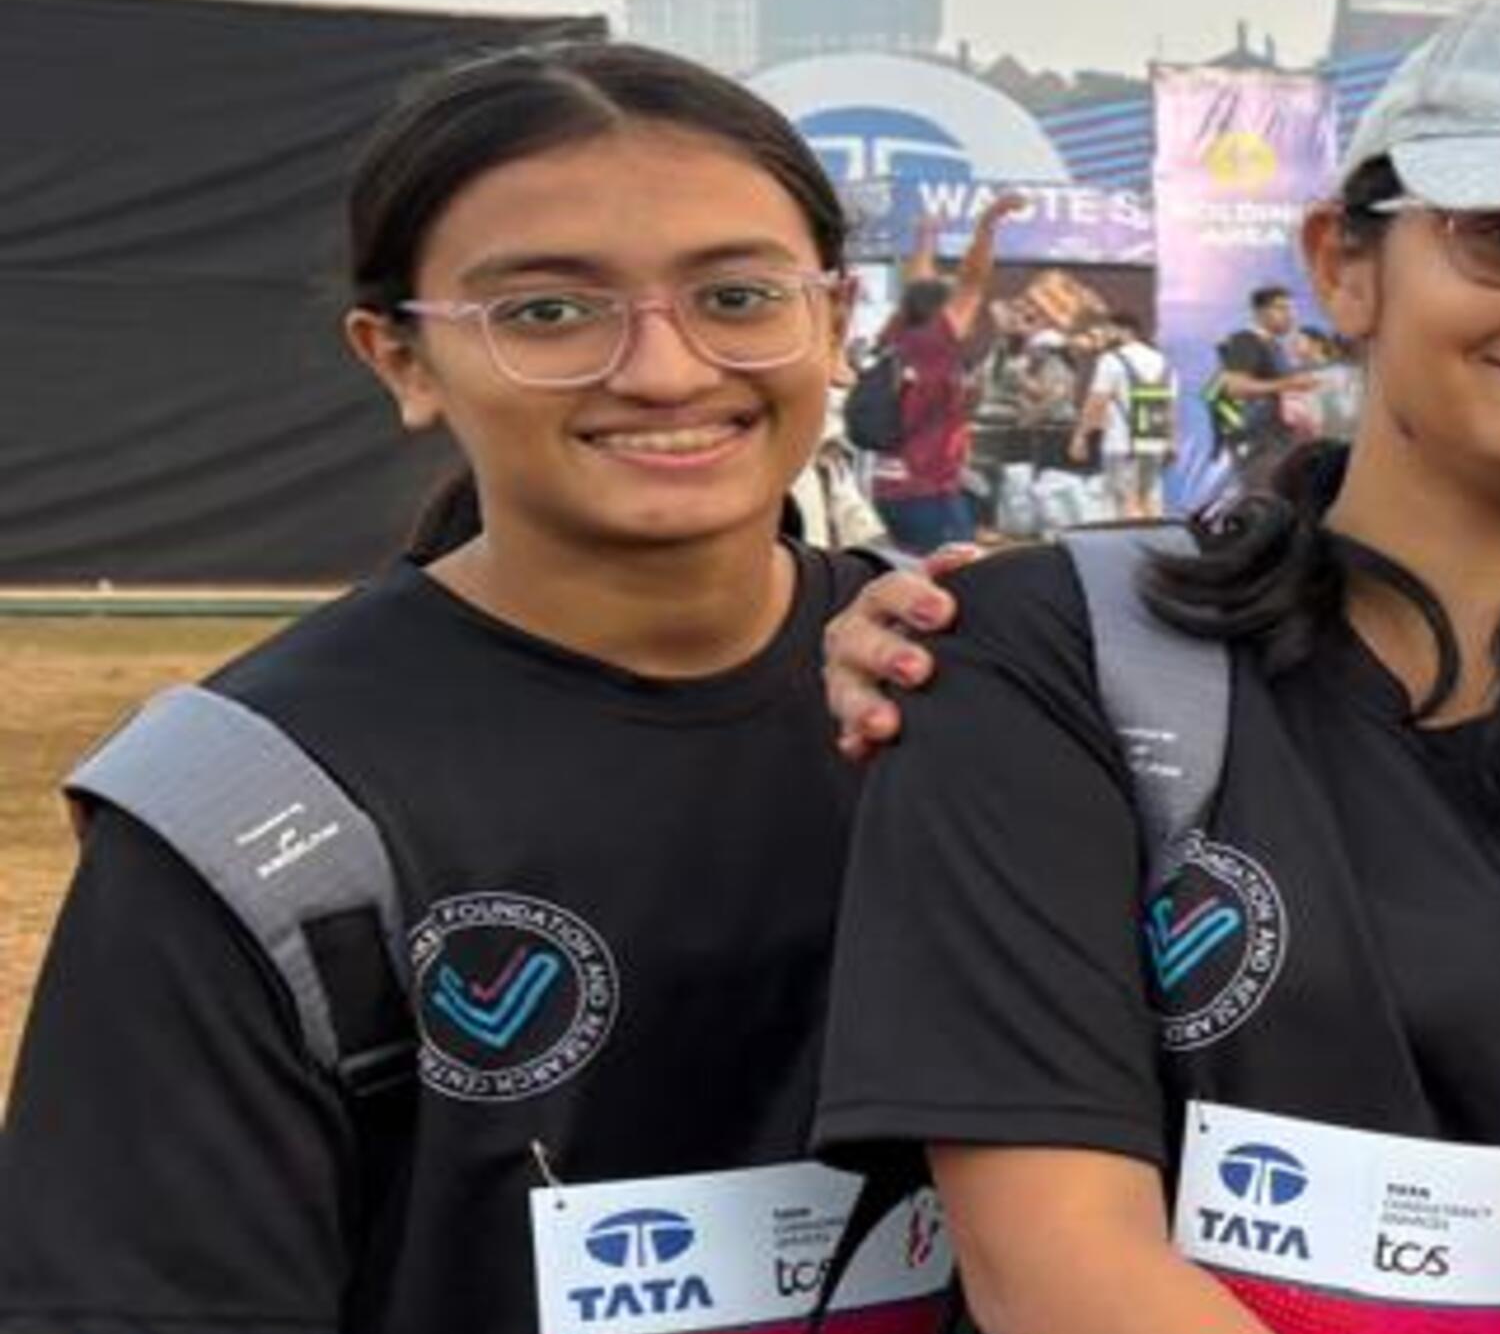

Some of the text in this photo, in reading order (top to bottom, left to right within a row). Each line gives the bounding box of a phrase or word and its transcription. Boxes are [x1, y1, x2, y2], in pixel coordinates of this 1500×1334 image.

[1197, 1209, 1310, 1260] TATA
[1373, 1232, 1450, 1278] tcs
[568, 1274, 714, 1322] TATA
